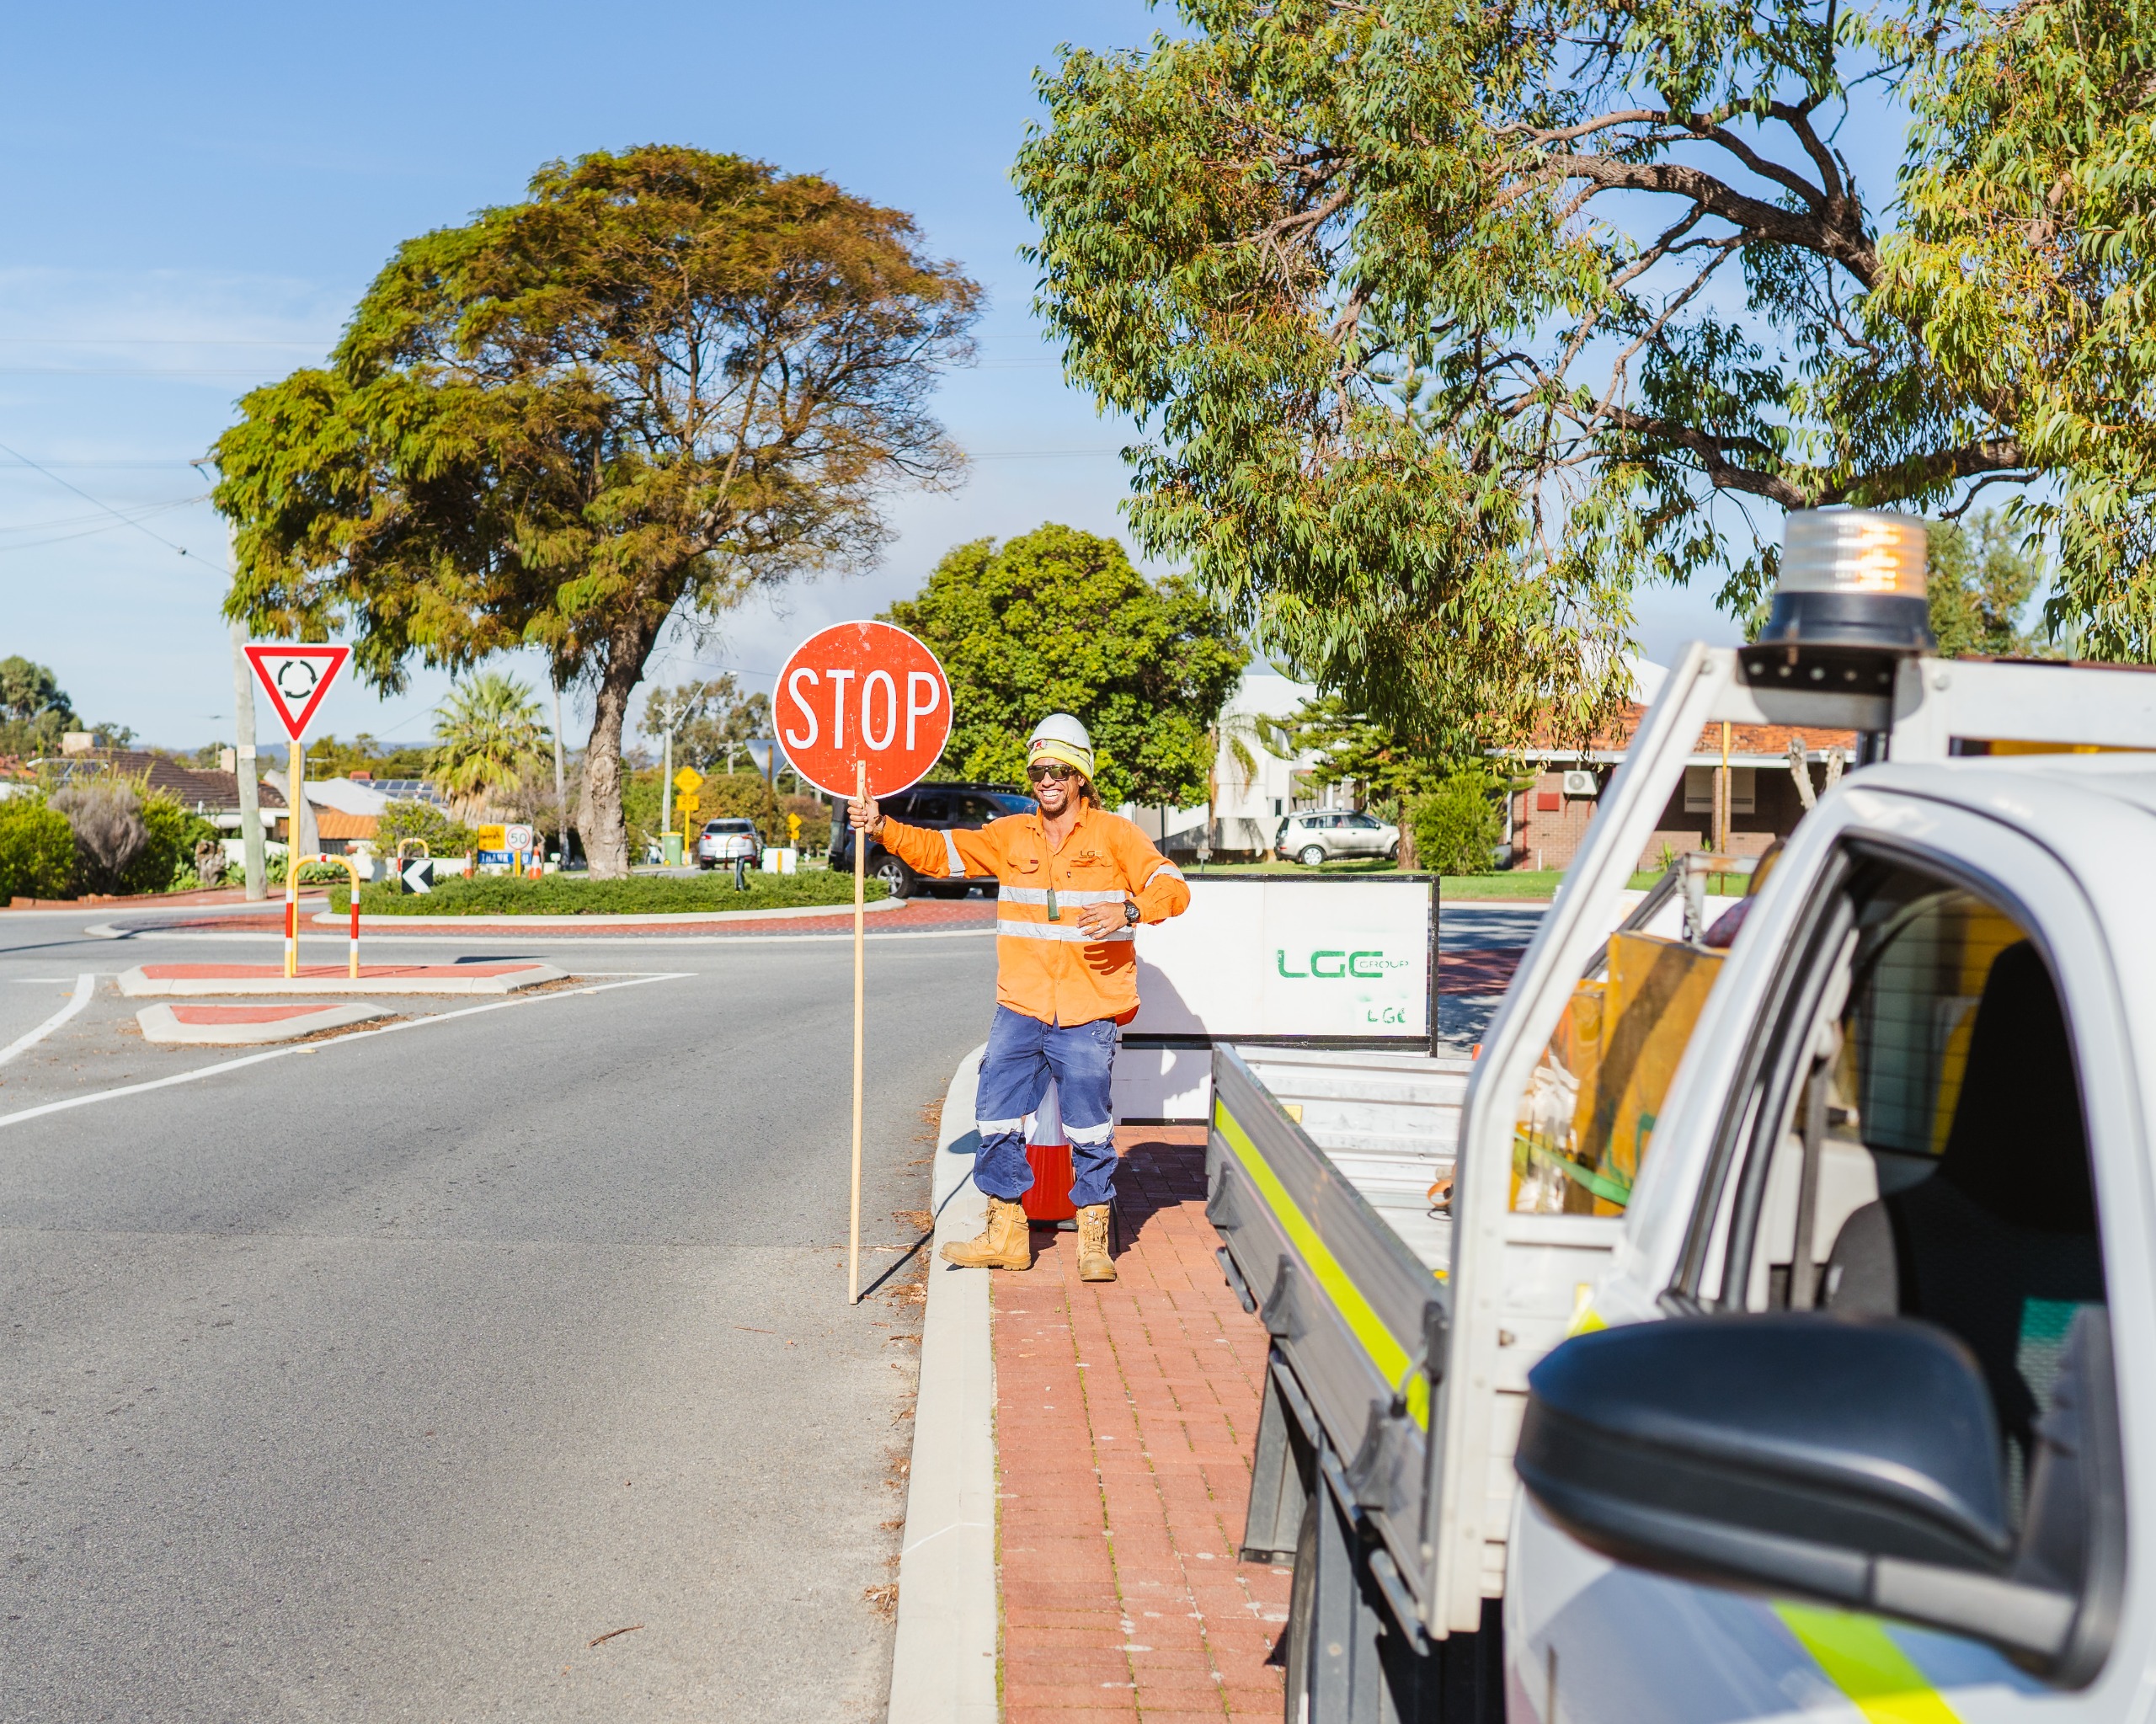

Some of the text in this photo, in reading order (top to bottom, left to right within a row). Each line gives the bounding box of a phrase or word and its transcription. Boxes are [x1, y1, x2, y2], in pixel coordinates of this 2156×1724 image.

[785, 667, 941, 751] STOP
[682, 797, 695, 805] 20
[510, 833, 527, 844] 50
[1277, 949, 1409, 979] LGC GROUP
